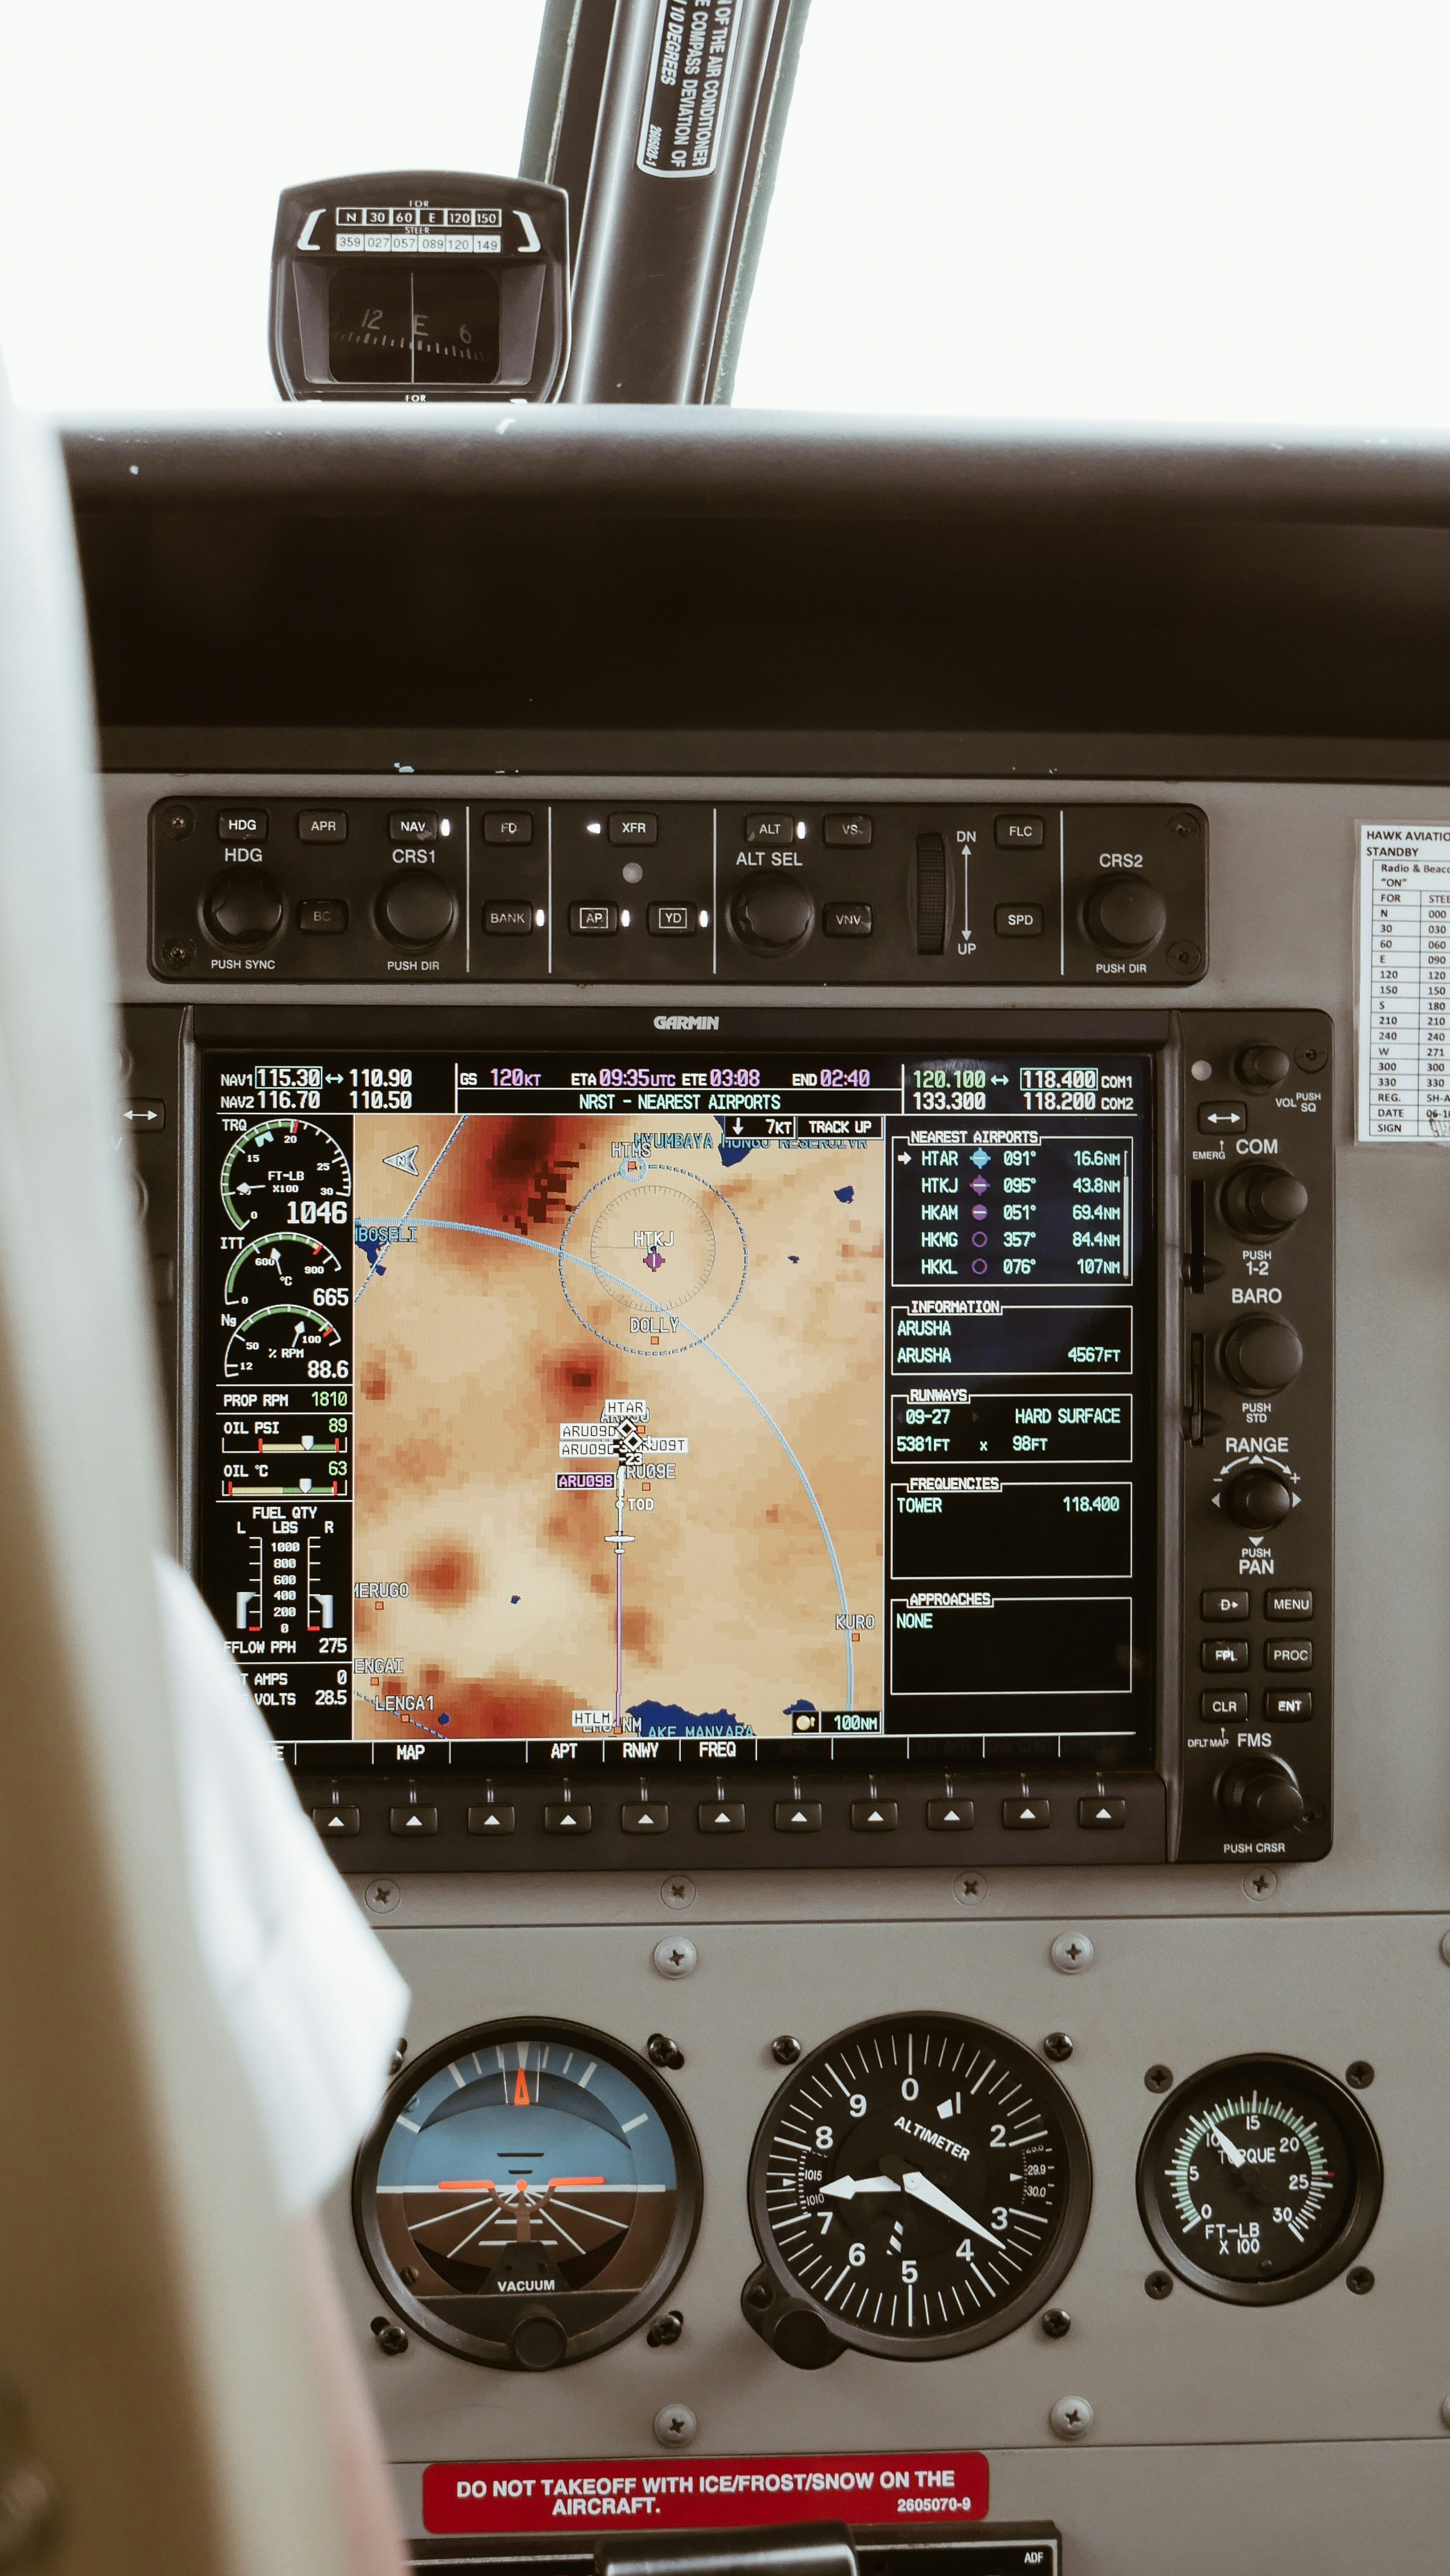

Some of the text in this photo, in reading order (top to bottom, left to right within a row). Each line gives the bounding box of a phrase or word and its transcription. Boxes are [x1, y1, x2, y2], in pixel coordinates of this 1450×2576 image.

[670, 6, 685, 22] 10
[715, 7, 731, 25] OF
[684, 11, 708, 75] COMPASS
[710, 27, 728, 54] THE
[660, 22, 683, 86] DEGREES
[705, 56, 723, 78] AIR
[673, 79, 698, 145] DEVIATION
[691, 80, 719, 167] CONDITIONER
[645, 124, 662, 167] 2605028-1
[671, 150, 687, 167] OF
[347, 212, 496, 224] N 30 60 E 120 150
[340, 238, 497, 250] 359 027 057 089 120 149
[228, 820, 256, 831] HDG
[622, 823, 646, 834] XFR
[957, 831, 976, 843] DN
[1367, 830, 1402, 840] HAWK
[225, 848, 263, 862] HDG
[392, 849, 436, 863] CRS1
[736, 852, 803, 866] ALT SEL
[1366, 847, 1419, 857] STANDBY
[1099, 853, 1143, 868] CRS2
[1381, 864, 1410, 872] Radio
[1381, 894, 1401, 903] FOR
[1008, 915, 1033, 926] SPD
[1429, 910, 1447, 918] 000
[957, 944, 976, 955] UP
[212, 959, 276, 970] PUSH SYNC
[388, 961, 440, 971] PUSH DIR
[1096, 964, 1147, 974] PUSH DIR
[1380, 970, 1446, 979] 120 120
[654, 1015, 719, 1031] GARMIN
[221, 1069, 412, 1087] NAV1 115.30 110.90
[460, 1069, 870, 1087] GS ETA ETE 03:08 END 02:40
[913, 1070, 1133, 1089] 120.100 118.400 COM1
[221, 1091, 412, 1108] NAV2 116.70 110.50
[579, 1094, 781, 1110] NRST NEAREST AIRPORTS
[913, 1092, 1134, 1110] 133.300 118.200 COM2
[1378, 1109, 1404, 1117] DATE
[808, 1120, 871, 1133] TRACK UP
[1378, 1124, 1402, 1133] SIGN
[911, 1130, 1038, 1143] NEAREST AIRPORTS
[1236, 1139, 1278, 1154] COM
[921, 1150, 958, 1166] HTAR
[921, 1177, 958, 1193] HTKJ
[287, 1201, 347, 1224] 1046
[921, 1204, 958, 1220] HKAM
[921, 1231, 958, 1248] HKMG
[1242, 1250, 1272, 1261] PUSH
[921, 1259, 958, 1275] HKKL
[313, 1287, 349, 1307] 665
[1231, 1288, 1283, 1304] BARO
[911, 1300, 1000, 1313] INFORMATION
[630, 1317, 679, 1333] DOLLY
[897, 1320, 952, 1336] ARUSHA
[897, 1347, 1121, 1363] ARUSHA 4567FT
[308, 1360, 349, 1378] 88.6
[224, 1391, 347, 1407] PROP RPM 1810
[910, 1389, 967, 1402] RUNWAYS
[905, 1407, 1121, 1424] 09-27 HARD SURFACE
[1242, 1402, 1272, 1413] PUSH
[1246, 1413, 1268, 1423] STD
[224, 1422, 279, 1434] OIL PSI
[1226, 1437, 1289, 1453] RANGE
[910, 1477, 1000, 1491] FREQUENCIES
[252, 1506, 318, 1519] FUEL QTY
[897, 1496, 1120, 1513] TOWER 118.400
[273, 1521, 299, 1534] LBS
[1241, 1548, 1272, 1558] PUSH
[1239, 1559, 1274, 1575] PAN
[910, 1593, 992, 1606] APPROACHES
[1274, 1599, 1309, 1610] MENU
[897, 1613, 933, 1629] NONE
[270, 1638, 347, 1653] PPH 275
[1274, 1650, 1308, 1661] PROC
[254, 1673, 288, 1685] AMPS
[315, 1689, 347, 1706] 28.5
[1212, 1701, 1237, 1712] CLR
[1237, 1733, 1272, 1747] FMS
[396, 1741, 737, 1761] MAP APT RNWY FREQ
[1224, 1843, 1285, 1853] PUSH CRSR
[901, 2078, 919, 2101] 0
[850, 2094, 866, 2118] 9
[815, 2126, 833, 2150] 8
[894, 2116, 970, 2161] ALTIMETER
[990, 2124, 1006, 2147] 2
[1280, 2137, 1300, 2153] 20
[1289, 2174, 1309, 2191] 25
[990, 2206, 1008, 2230] 3
[1272, 2207, 1293, 2223] 30
[1205, 2222, 1260, 2239] FT-LB
[1237, 2238, 1260, 2253] 100
[497, 2280, 555, 2292] VACUUM
[456, 2470, 955, 2498] DO NOT TAKEOFF WITH ICE/FROST/SNOW ON THE
[552, 2496, 661, 2516] AIRCRAFT.
[897, 2497, 971, 2513] 2605070-9
[1024, 2551, 1044, 2564] ADF
